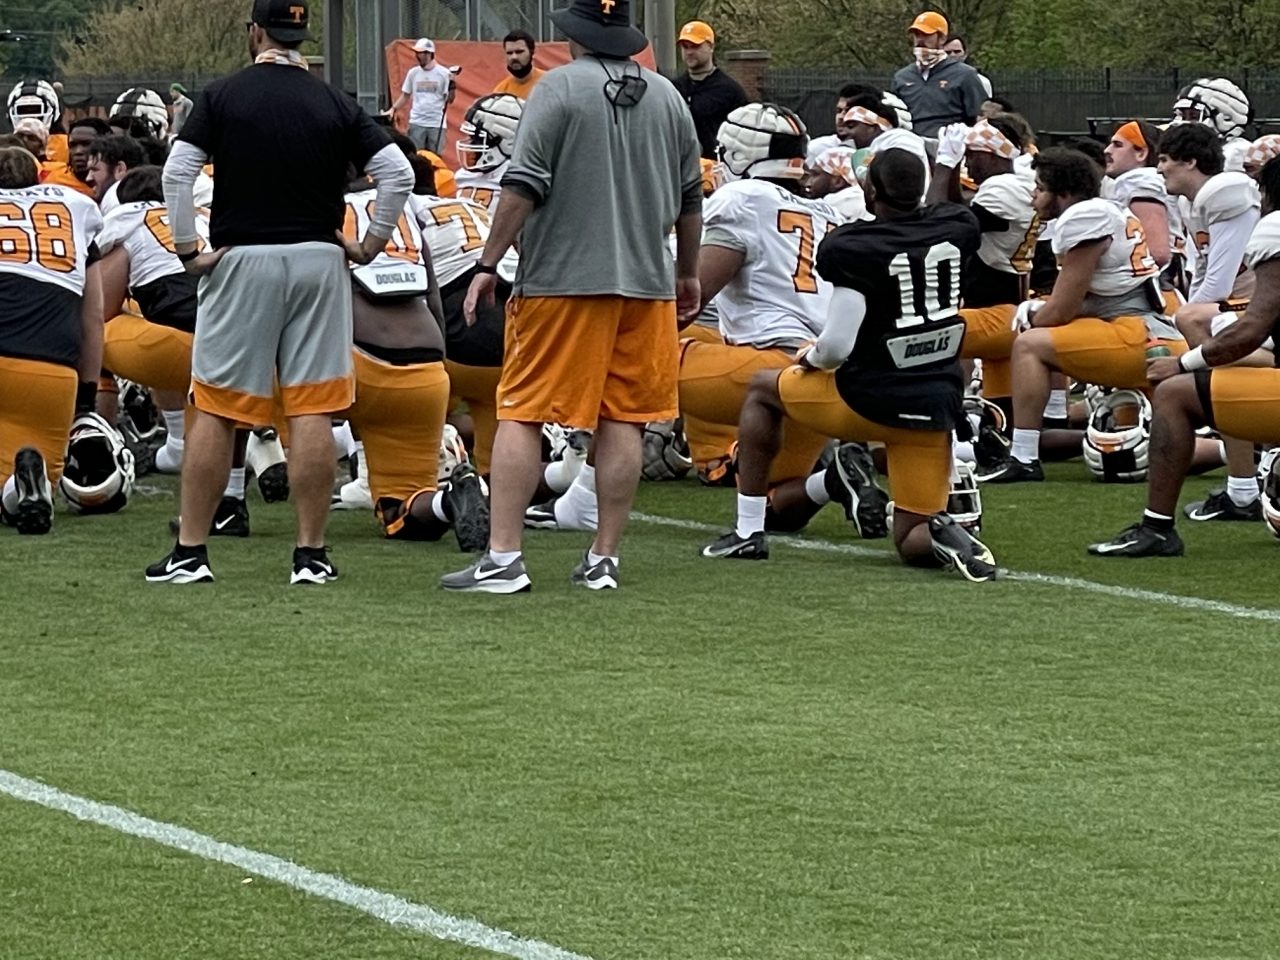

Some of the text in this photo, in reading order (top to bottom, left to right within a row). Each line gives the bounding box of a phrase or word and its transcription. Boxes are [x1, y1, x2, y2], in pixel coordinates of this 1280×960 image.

[289, 6, 305, 23] T
[601, 0, 616, 14] T
[375, 272, 417, 285] DOUGLAS
[888, 241, 961, 328] 10
